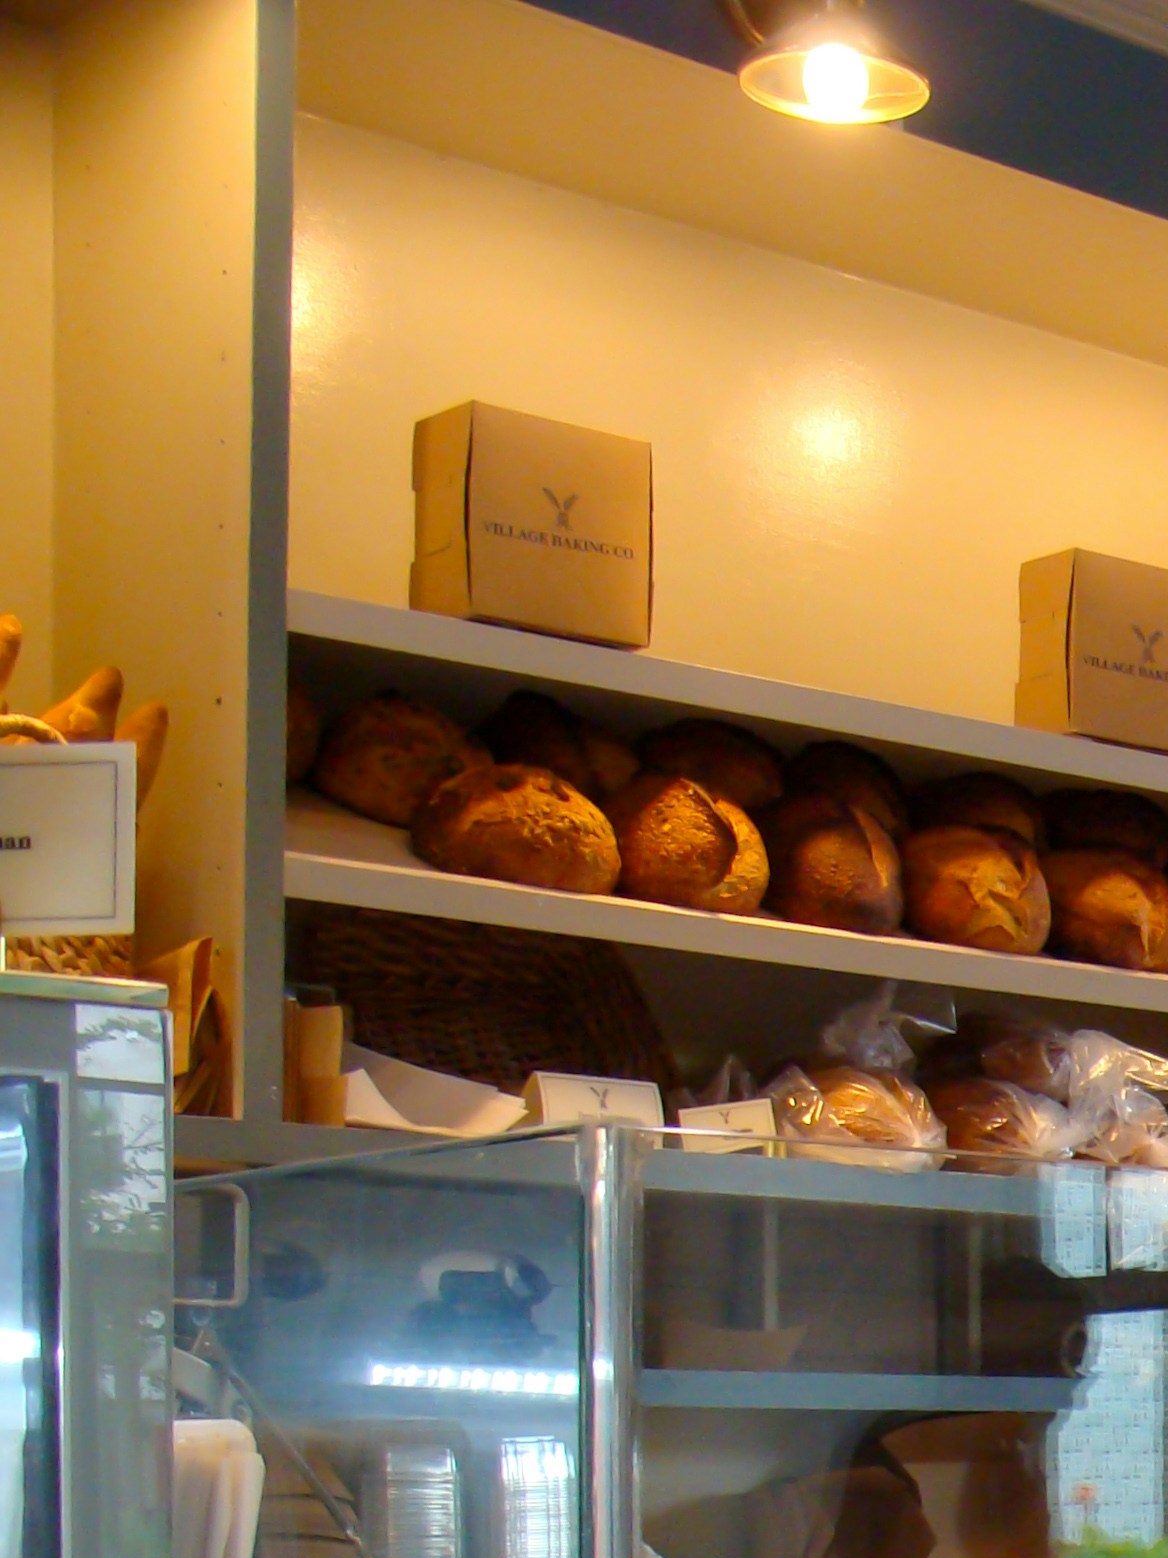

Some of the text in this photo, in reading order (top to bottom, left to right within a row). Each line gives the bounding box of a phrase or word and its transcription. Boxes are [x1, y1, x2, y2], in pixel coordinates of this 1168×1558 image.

[484, 522, 549, 545] VILLAGE
[551, 533, 610, 555] BAKING
[1083, 655, 1134, 676] VILLAGE
